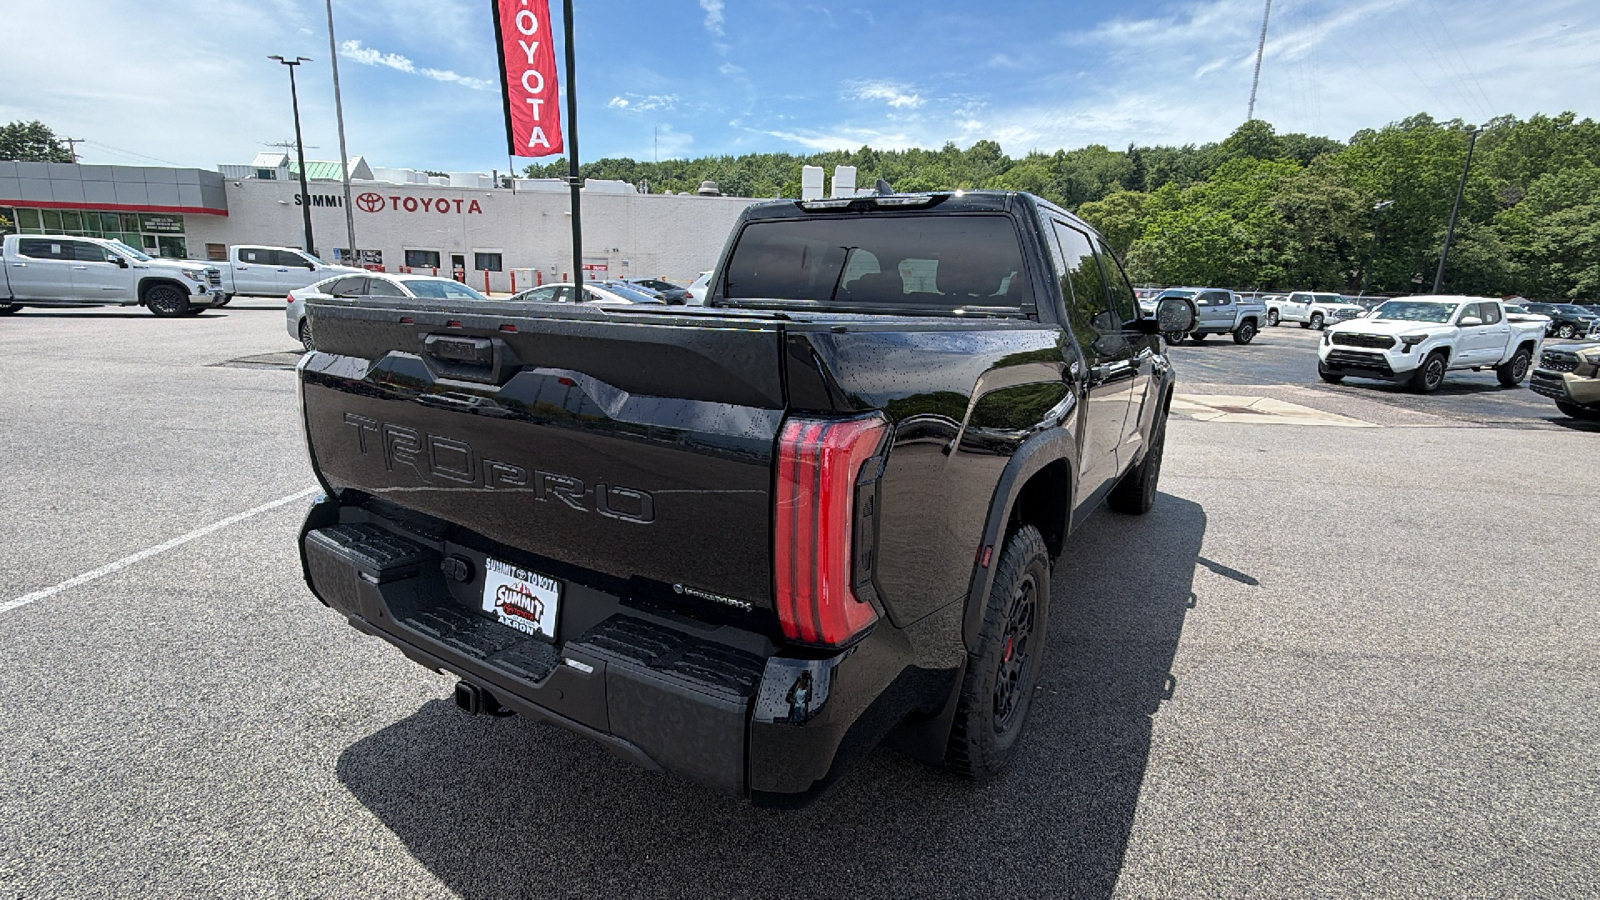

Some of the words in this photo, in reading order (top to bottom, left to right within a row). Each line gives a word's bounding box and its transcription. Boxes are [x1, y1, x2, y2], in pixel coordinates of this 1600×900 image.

[515, 0, 550, 148] OYOTA
[388, 196, 482, 214] TOYOTA
[343, 412, 476, 484] TRD
[483, 457, 655, 524] PRO
[485, 557, 517, 578] SUMMIT
[527, 571, 558, 593] TOYOTA
[496, 586, 543, 621] SUMMIT
[513, 608, 534, 621] TOYOTA
[498, 616, 534, 636] AKRON
